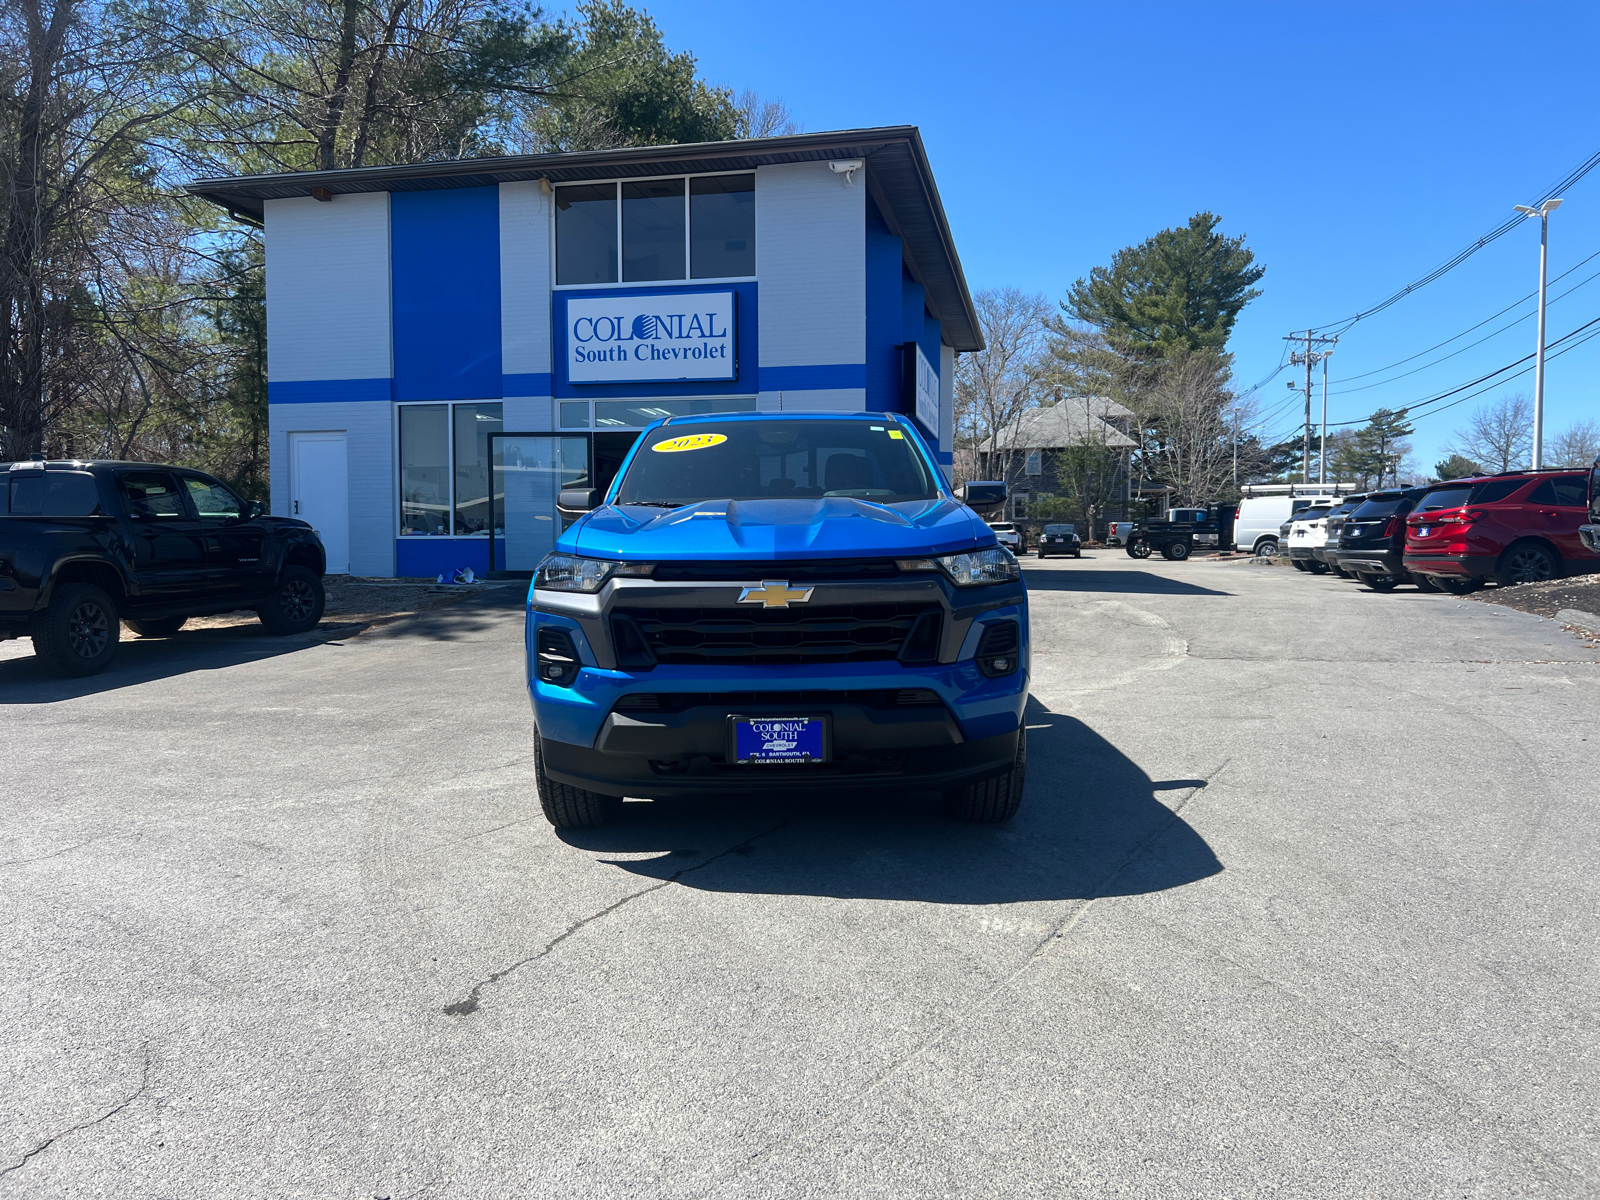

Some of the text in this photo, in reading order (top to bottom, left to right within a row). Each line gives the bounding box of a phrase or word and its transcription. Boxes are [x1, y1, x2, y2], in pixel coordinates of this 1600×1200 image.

[573, 313, 727, 343] COLONIAL
[575, 342, 727, 363] South Chevrolet
[666, 436, 713, 450] 2023
[753, 723, 806, 732] COLONIAL
[761, 731, 798, 741] SOUTH
